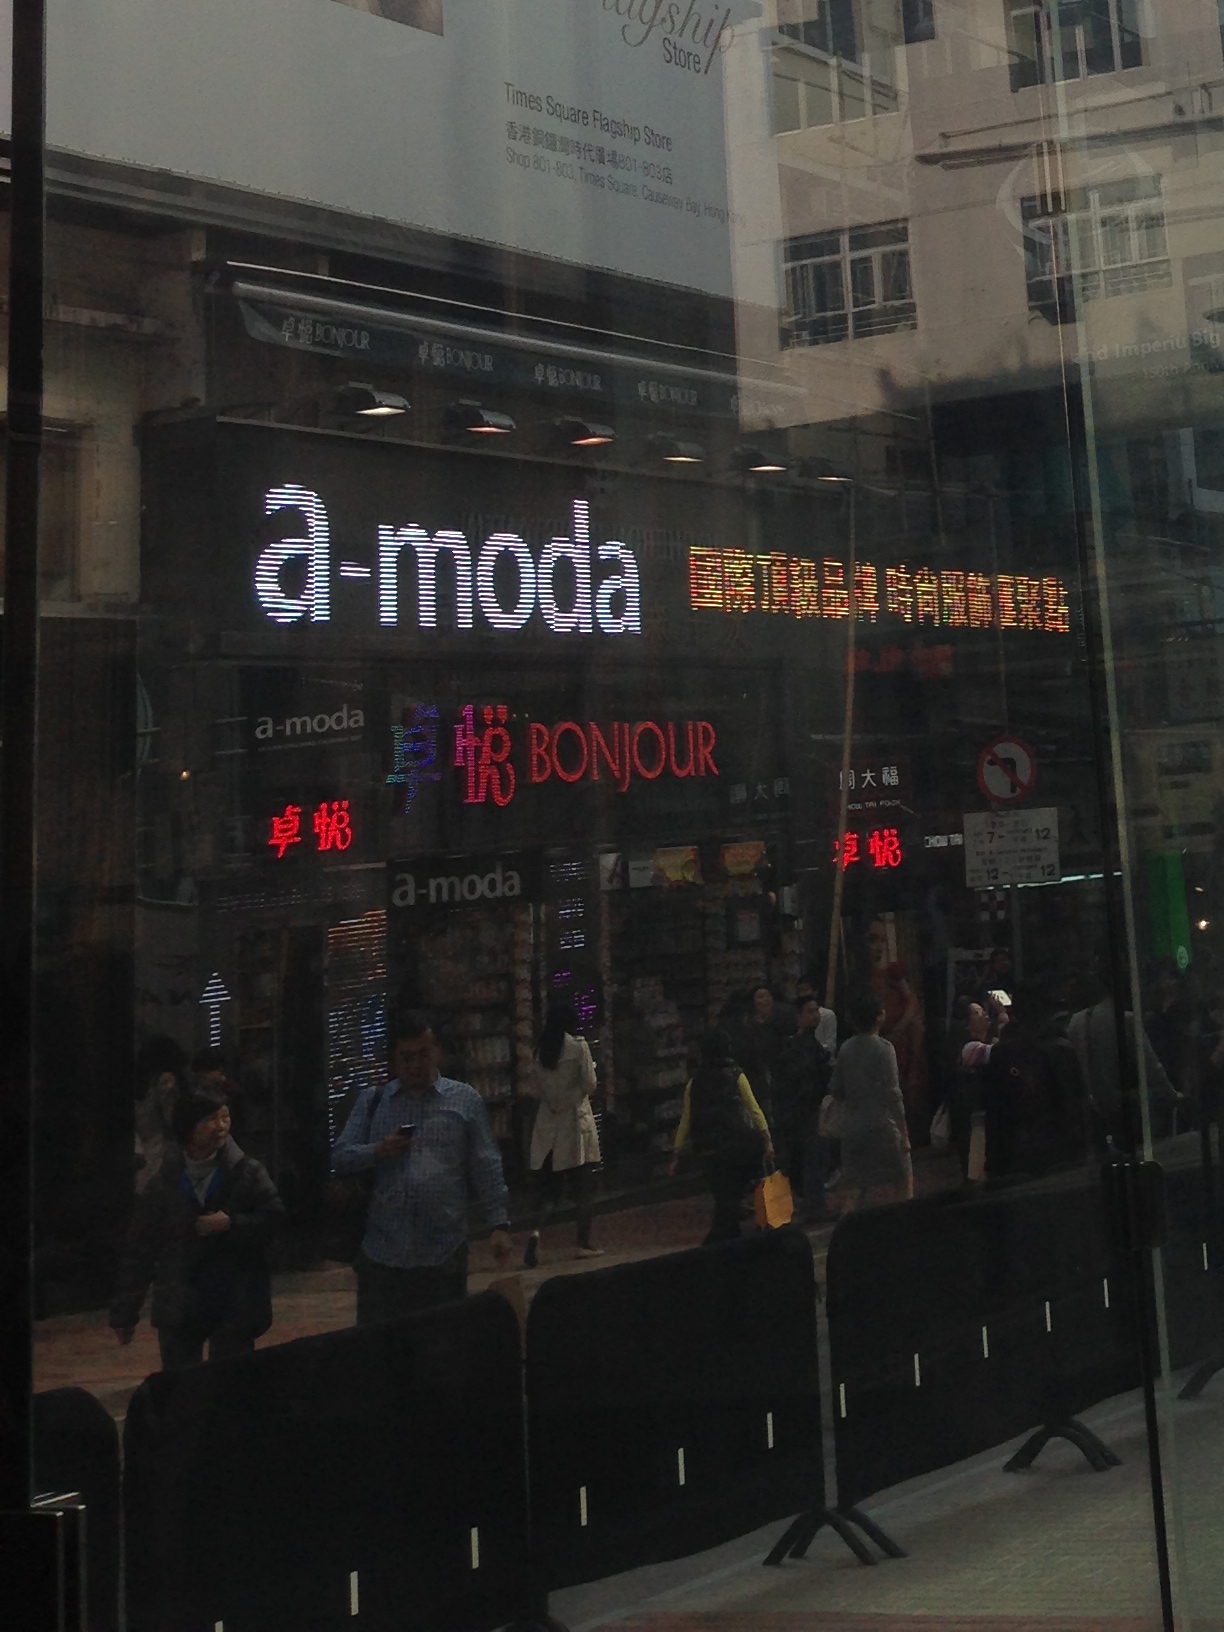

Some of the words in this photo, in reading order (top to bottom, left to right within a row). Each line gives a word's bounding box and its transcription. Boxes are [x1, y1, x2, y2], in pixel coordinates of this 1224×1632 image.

[662, 37, 701, 74] Store
[504, 82, 542, 113] Times
[546, 95, 589, 127] Square
[592, 109, 641, 145] Flagship
[643, 125, 673, 153] Store
[506, 146, 531, 171] Shop
[579, 167, 605, 189] Times
[315, 321, 370, 351] BONJOUR
[446, 346, 494, 372] BONJOUR
[254, 482, 642, 635] a-moda
[255, 705, 364, 740] a-moda
[529, 721, 719, 793] BONJOUR
[1035, 827, 1051, 840] 12
[392, 862, 521, 908] a-moda
[1040, 863, 1056, 877] 12
